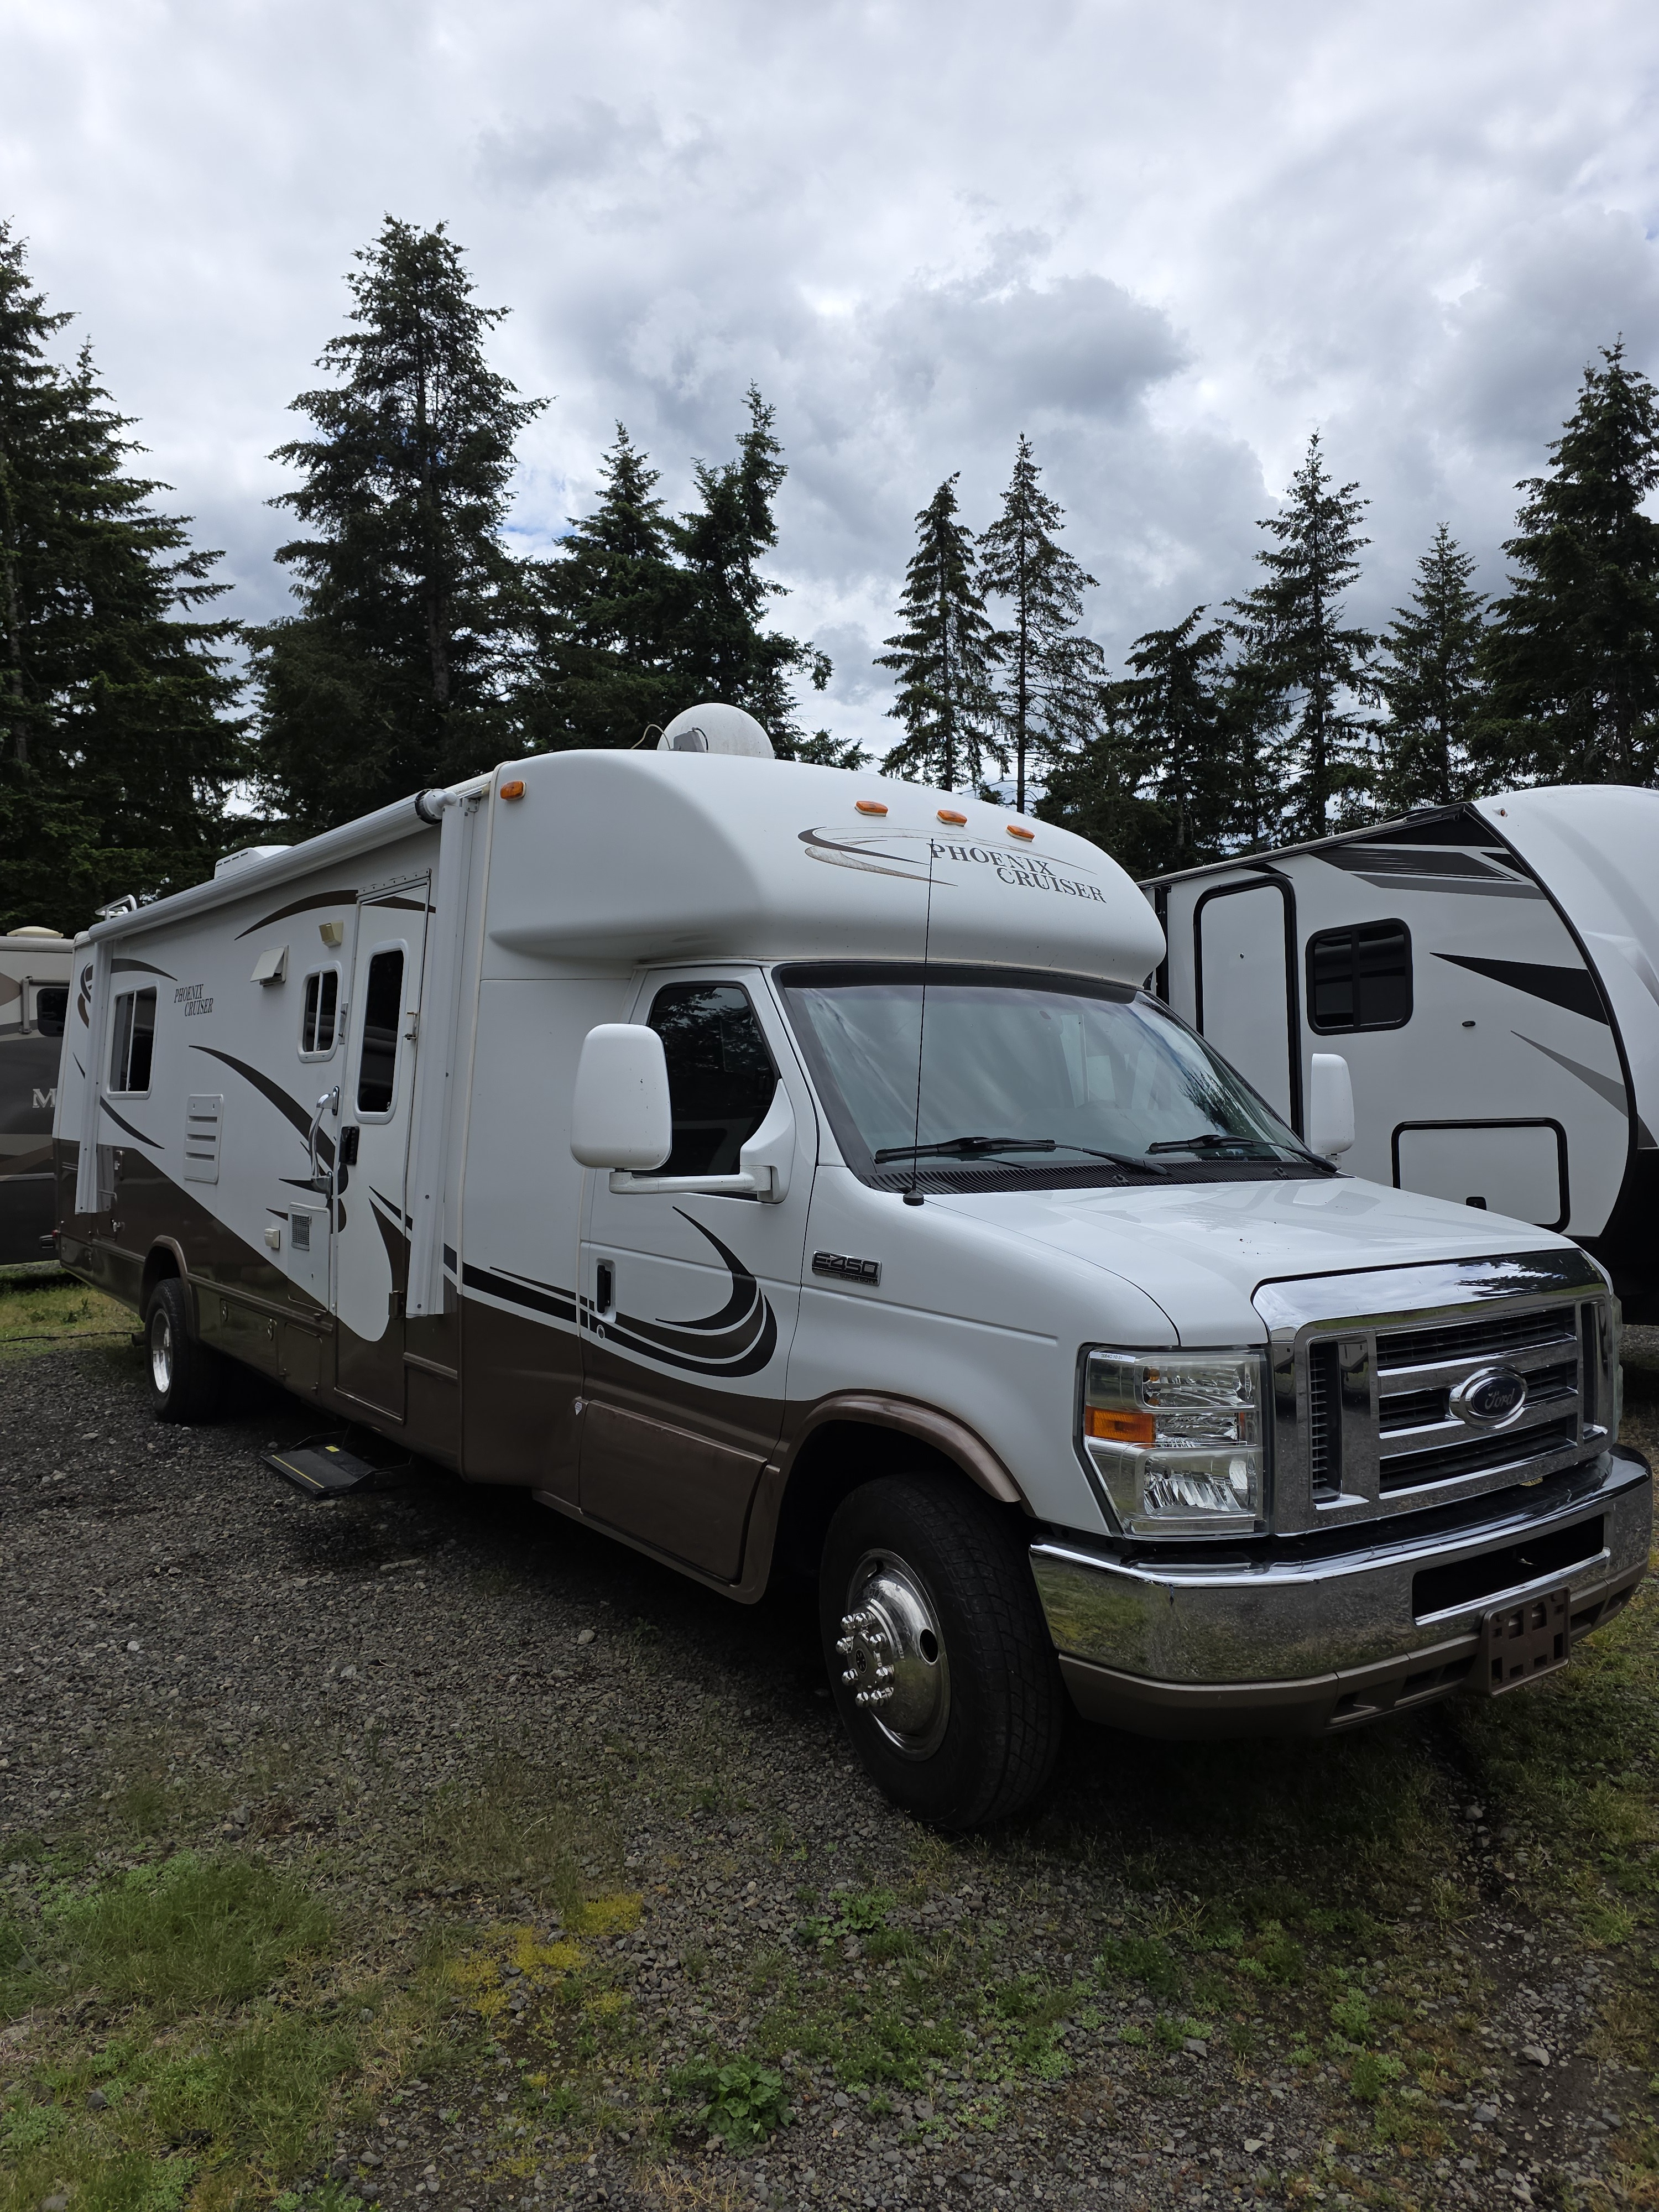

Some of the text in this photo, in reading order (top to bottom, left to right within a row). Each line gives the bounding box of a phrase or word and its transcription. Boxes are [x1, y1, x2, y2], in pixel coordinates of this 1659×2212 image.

[926, 843, 1056, 877] PHOENIX
[997, 867, 1107, 904] CRUISER
[174, 984, 204, 1003] PHOENIX
[184, 998, 213, 1016] CRUISER
[813, 1252, 878, 1278] E-450
[1484, 1385, 1515, 1410] Ford
